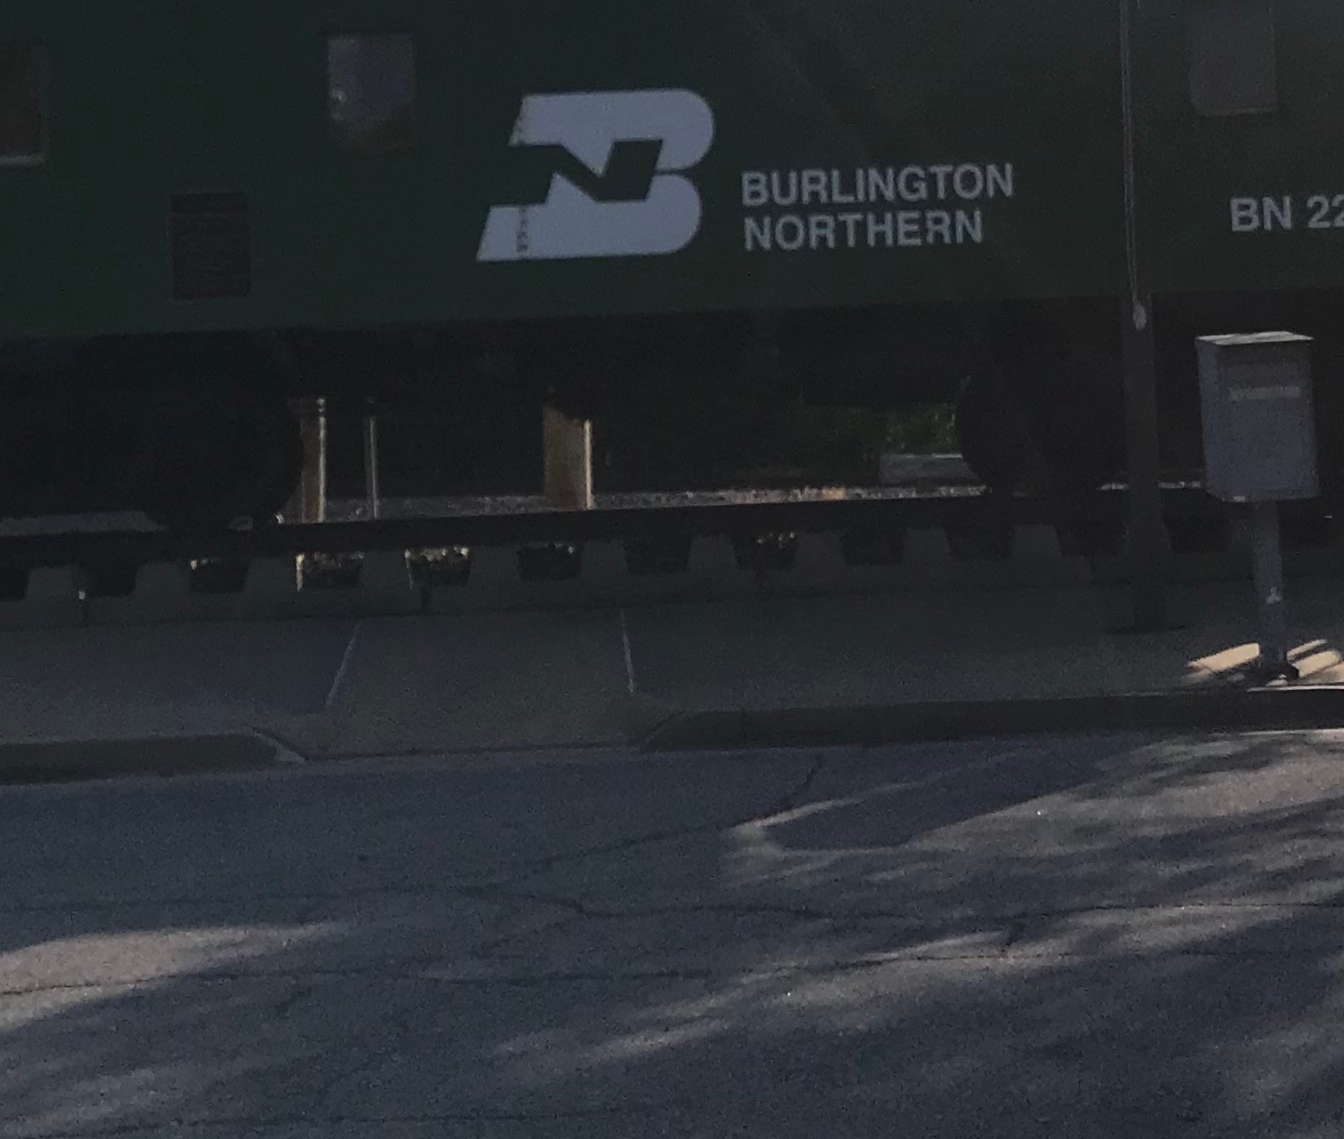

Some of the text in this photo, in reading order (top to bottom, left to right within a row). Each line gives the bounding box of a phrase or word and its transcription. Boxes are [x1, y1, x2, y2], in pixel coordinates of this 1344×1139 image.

[741, 162, 1014, 206] BURLINGTON
[743, 209, 983, 251] NORTHERN
[1230, 195, 1293, 232] BN
